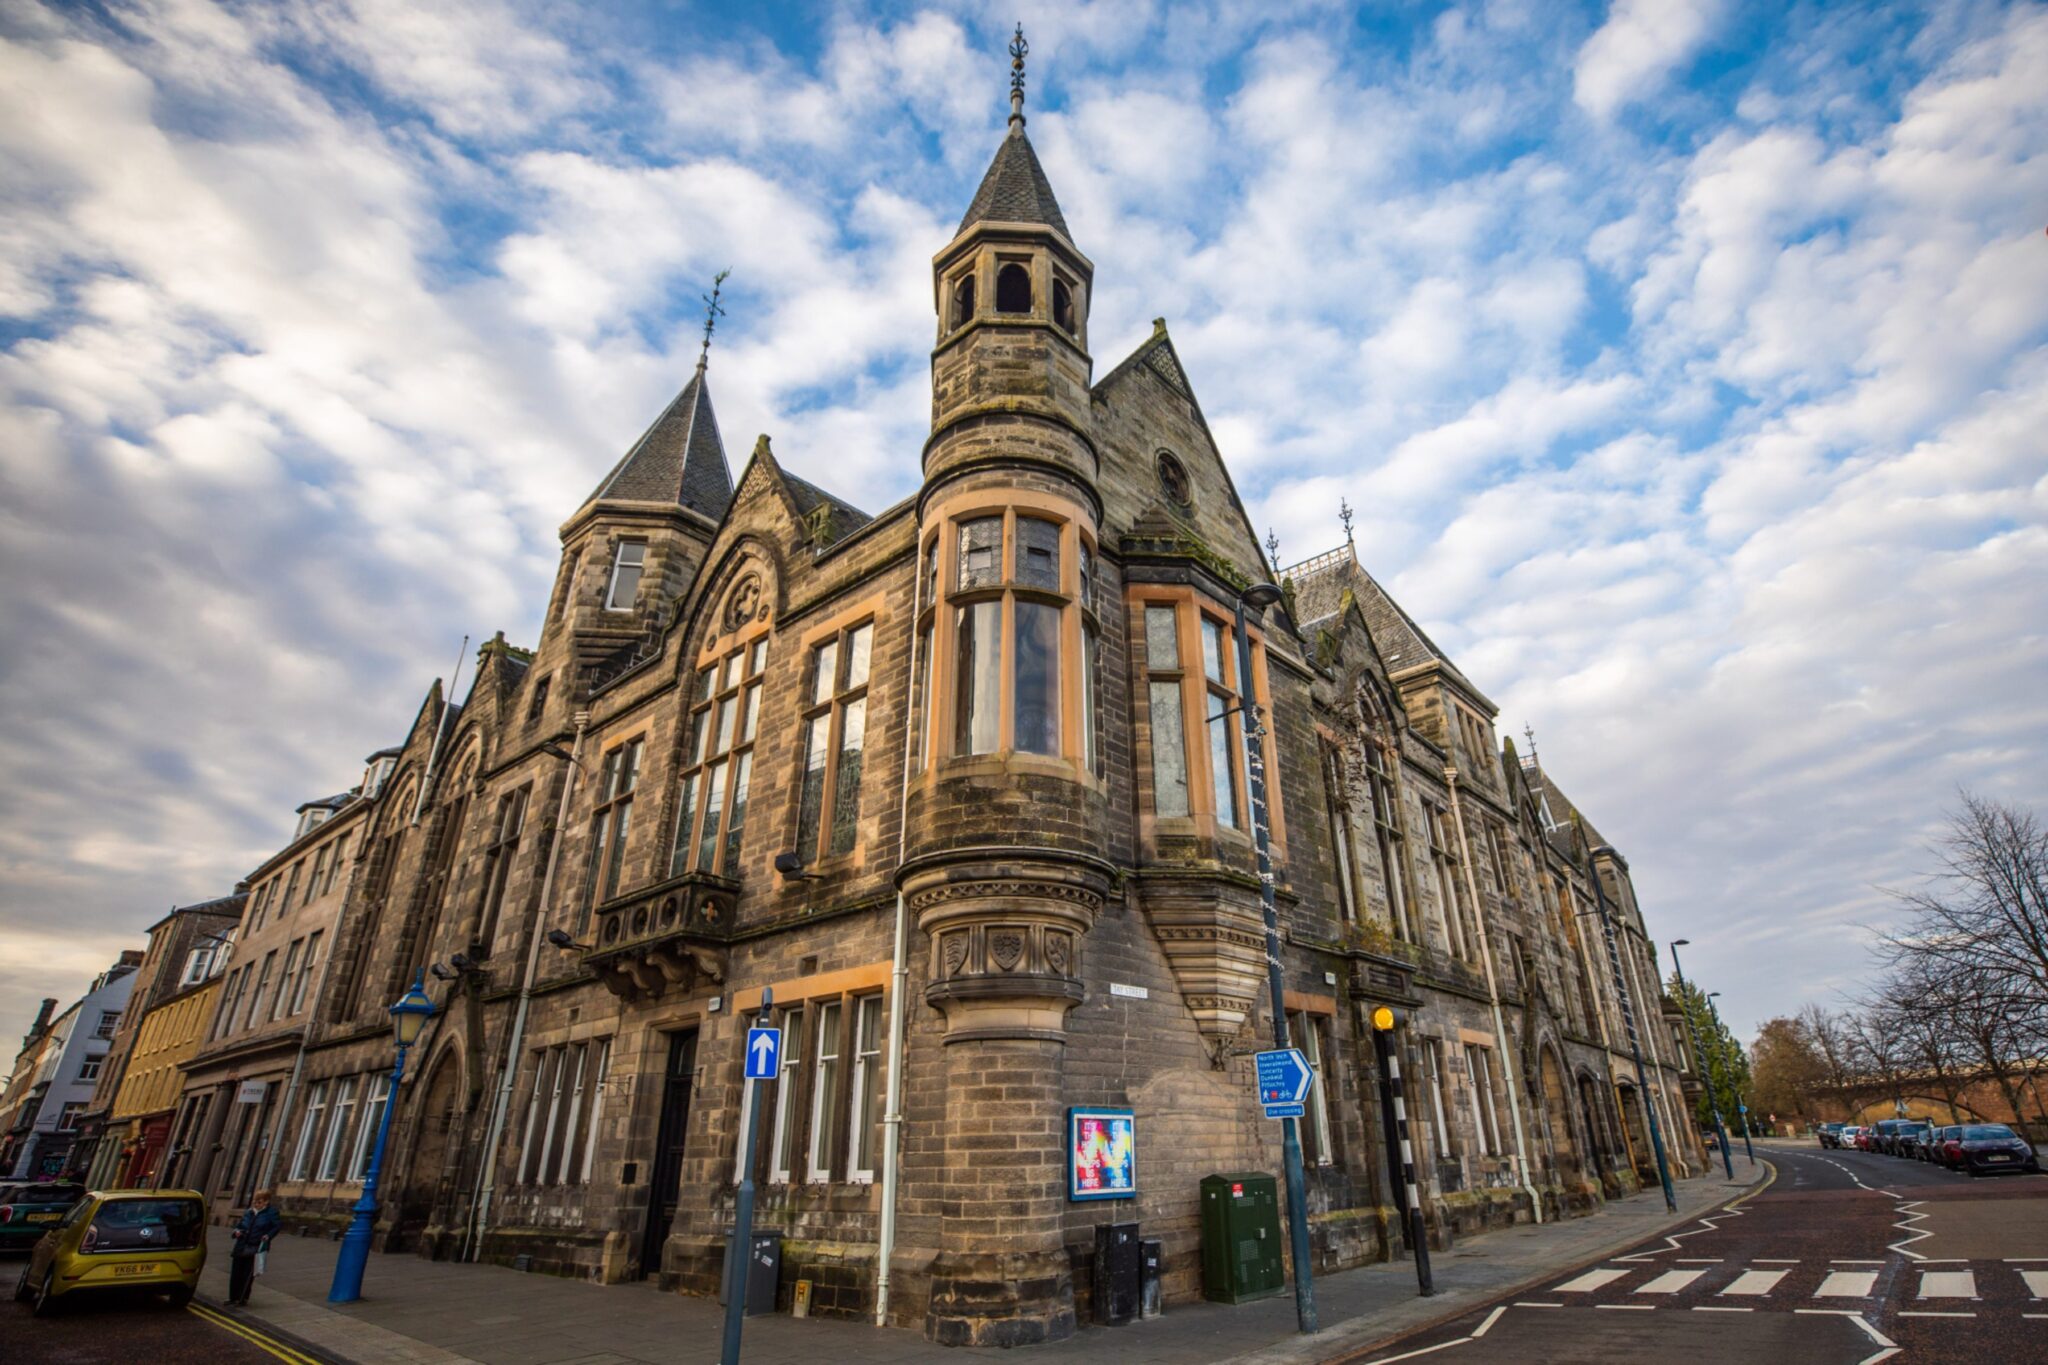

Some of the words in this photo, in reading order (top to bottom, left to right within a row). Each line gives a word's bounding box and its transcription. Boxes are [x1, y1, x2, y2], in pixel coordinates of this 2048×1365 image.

[1125, 987, 1146, 997] STREET
[1260, 1074, 1283, 1082] Dunkeld
[1279, 1107, 1302, 1116] crossing
[1081, 1178, 1099, 1187] HERE
[1110, 1178, 1127, 1187] HERE
